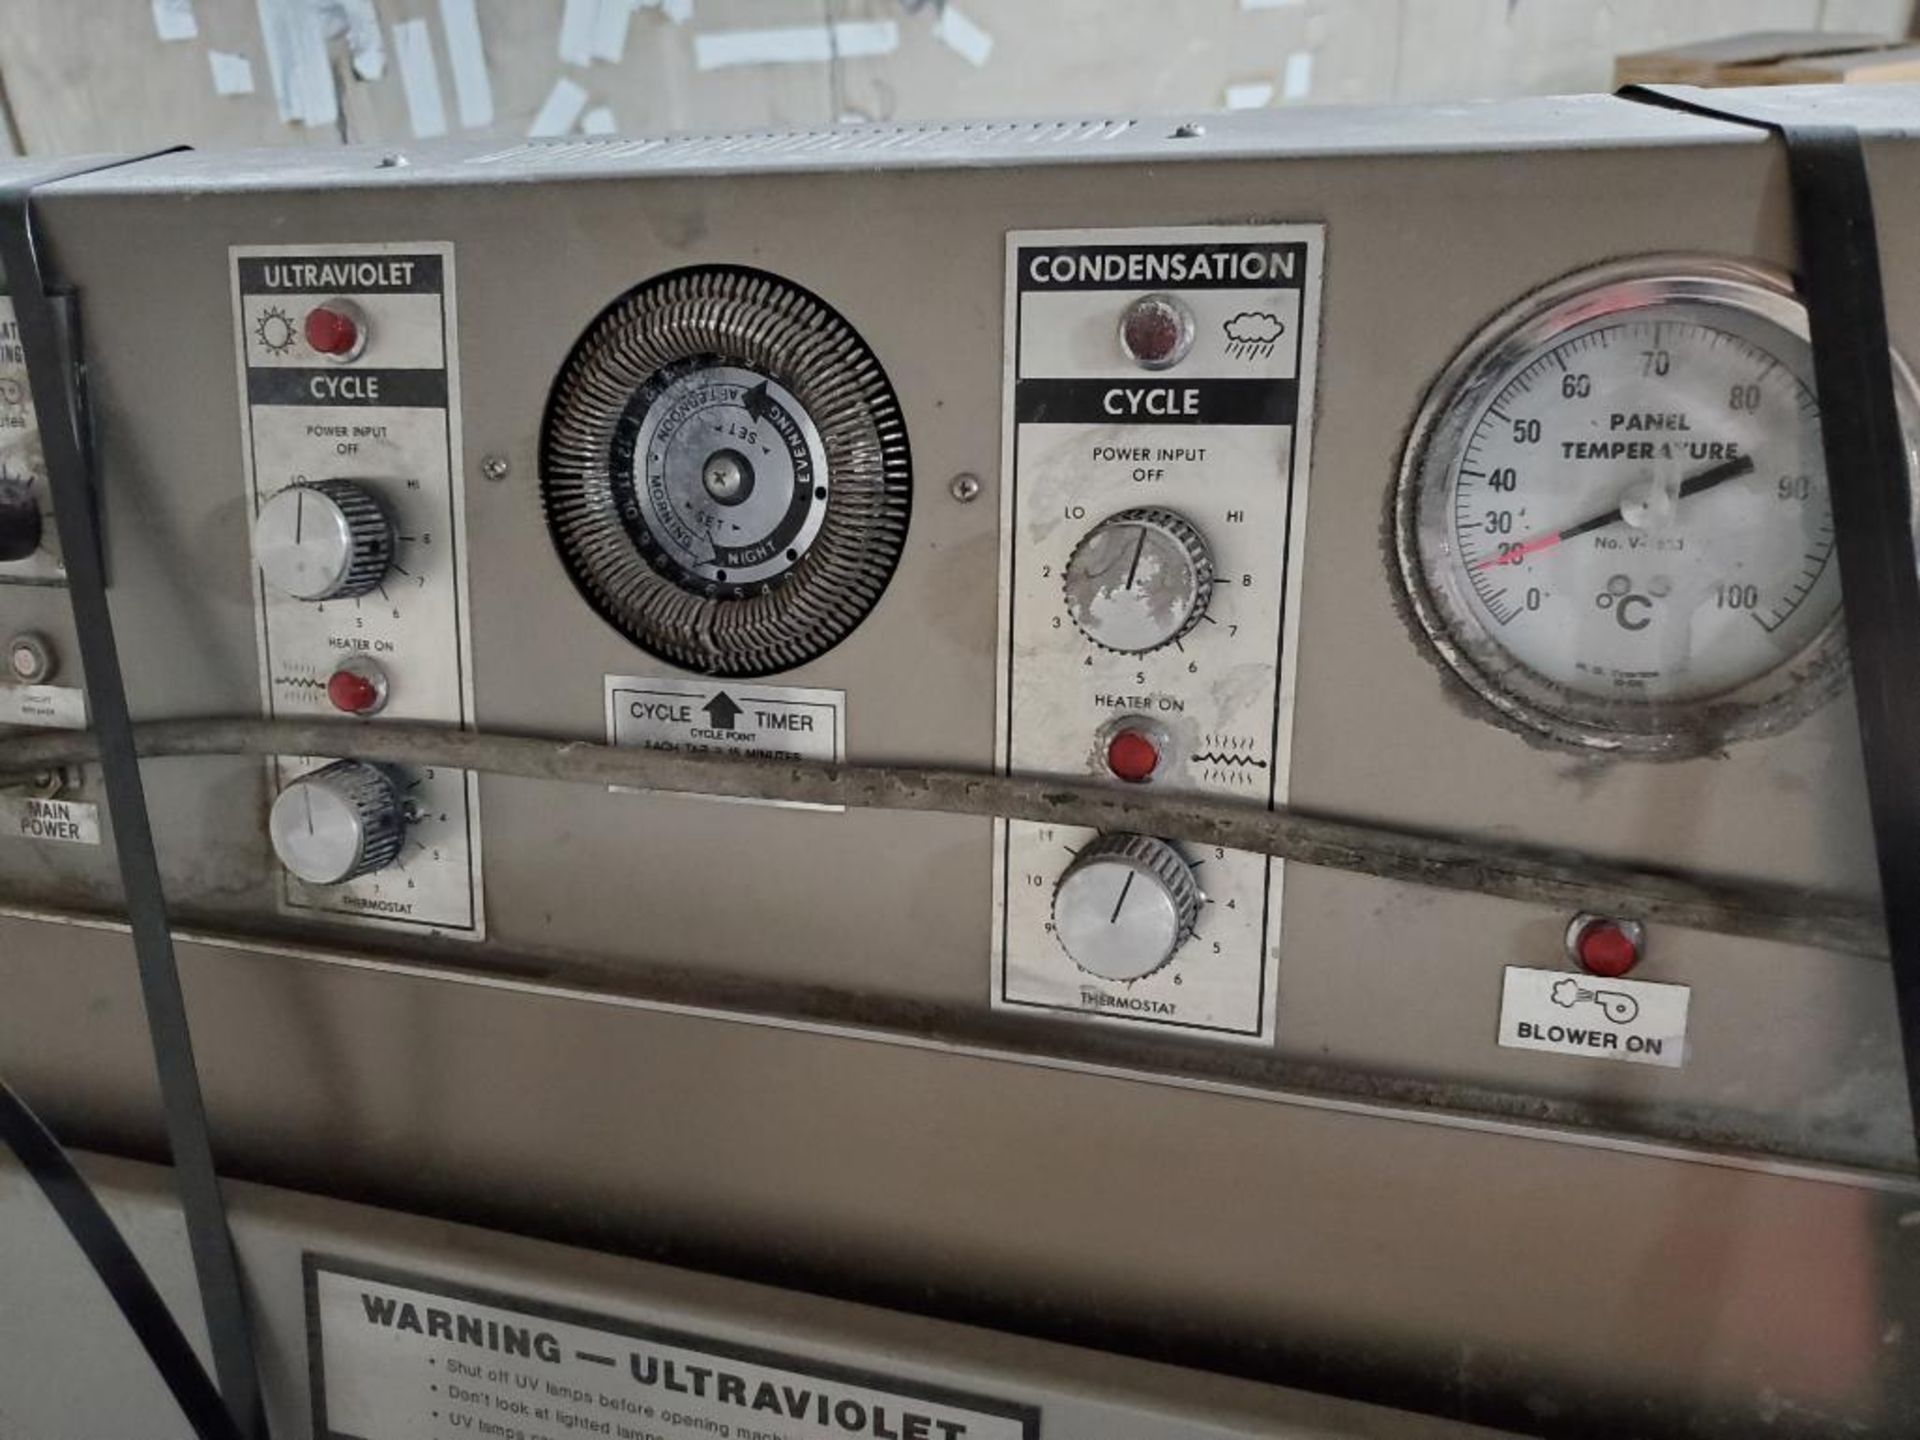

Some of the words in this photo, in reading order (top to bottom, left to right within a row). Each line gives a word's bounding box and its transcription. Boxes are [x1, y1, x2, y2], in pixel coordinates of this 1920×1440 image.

[263, 262, 415, 288] ULTRAVIOLET
[1029, 252, 1295, 283] CONDENSATION
[1641, 351, 1671, 377] 70
[309, 375, 380, 400] CYCLE
[1562, 374, 1591, 399] 60
[1103, 388, 1200, 416] CYCLE
[1729, 385, 1761, 412] 80
[656, 388, 738, 442] AFTERNOON
[1610, 412, 1691, 432] PANEL
[306, 426, 349, 438] POWER
[352, 426, 388, 438] INPUT
[727, 422, 758, 445] SET
[1512, 419, 1542, 444] 50
[336, 442, 359, 455] OFF
[768, 405, 811, 484] EVENING
[1092, 448, 1151, 462] POWER
[1156, 449, 1207, 463] INPUT
[1131, 468, 1166, 483] OFF
[1488, 469, 1517, 492] 40
[1777, 475, 1810, 502] 90
[650, 474, 695, 549] MORNING
[1064, 506, 1086, 520] LO
[1226, 510, 1244, 523] HI
[1484, 510, 1512, 534] 30
[727, 540, 776, 566] NIGHT
[1498, 542, 1525, 566] 20
[1042, 566, 1051, 578] 2
[1242, 574, 1252, 587] 8
[1526, 588, 1540, 611] 0
[1715, 584, 1759, 610] 100
[1051, 616, 1062, 629] 3
[1228, 624, 1239, 638] 7
[328, 638, 371, 650] HEATER
[374, 640, 395, 651] ON
[1083, 655, 1094, 667] 4
[1188, 661, 1199, 674] 6
[1136, 672, 1146, 685] 5
[1094, 693, 1152, 709] HEATER
[1158, 696, 1185, 713] ON
[629, 701, 692, 723] CYCLE
[754, 711, 814, 732] TIMER
[689, 728, 724, 741] CYCLE
[725, 732, 757, 743] POINT
[28, 800, 71, 821] MAIN
[20, 816, 80, 840] POWER
[1214, 847, 1225, 860] 3
[1026, 874, 1043, 887] 10
[343, 895, 414, 915] THERMOSTAT
[1225, 898, 1236, 910] 4
[1212, 941, 1222, 954] 5
[1173, 974, 1183, 986] 6
[1080, 990, 1177, 1016] THERMOSTAT
[1516, 1022, 1618, 1050] BLOWER
[1626, 1034, 1663, 1056] ON
[360, 1292, 562, 1364] WARNING
[629, 1351, 967, 1440] ULTRAVIOLET
[446, 1357, 482, 1379] Shut
[487, 1368, 510, 1385] off
[514, 1374, 540, 1391] UV
[545, 1380, 593, 1405] lamps
[598, 1391, 654, 1418] before
[659, 1407, 730, 1439] opening
[448, 1383, 490, 1408] Don't
[495, 1395, 530, 1416] look
[534, 1406, 550, 1420] at
[555, 1409, 610, 1435] lighted
[448, 1411, 473, 1429] UV
